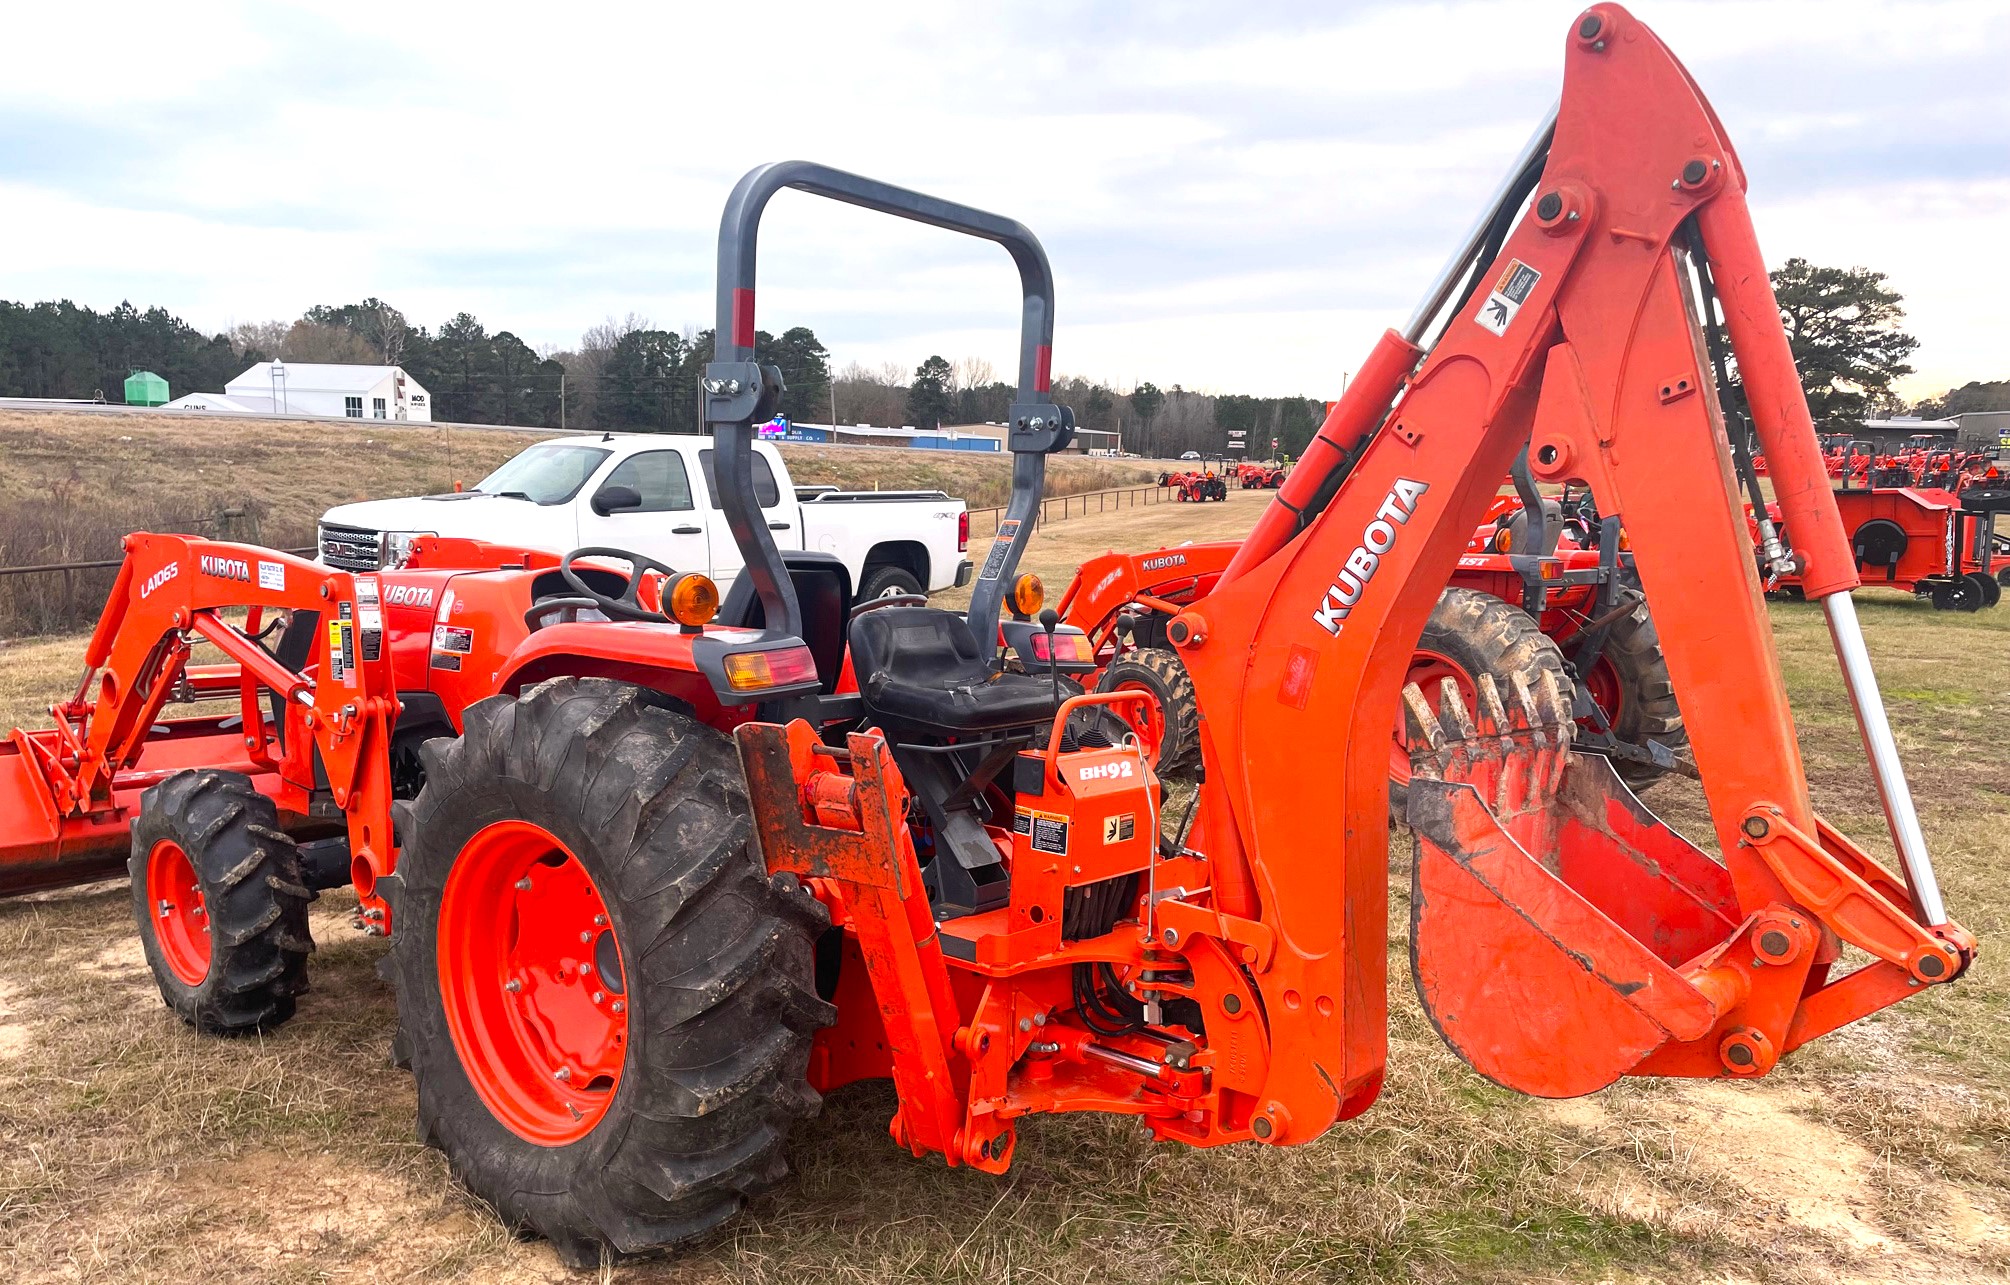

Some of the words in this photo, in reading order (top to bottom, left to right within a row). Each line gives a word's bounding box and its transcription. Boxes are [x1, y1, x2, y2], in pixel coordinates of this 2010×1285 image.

[201, 554, 250, 583] KUBOTA
[1142, 554, 1187, 571] KUBOTA
[1312, 477, 1431, 638] KUBOTA
[140, 561, 178, 599] LA1065
[383, 584, 434, 608] UBOTA
[1080, 761, 1133, 780] BH92
